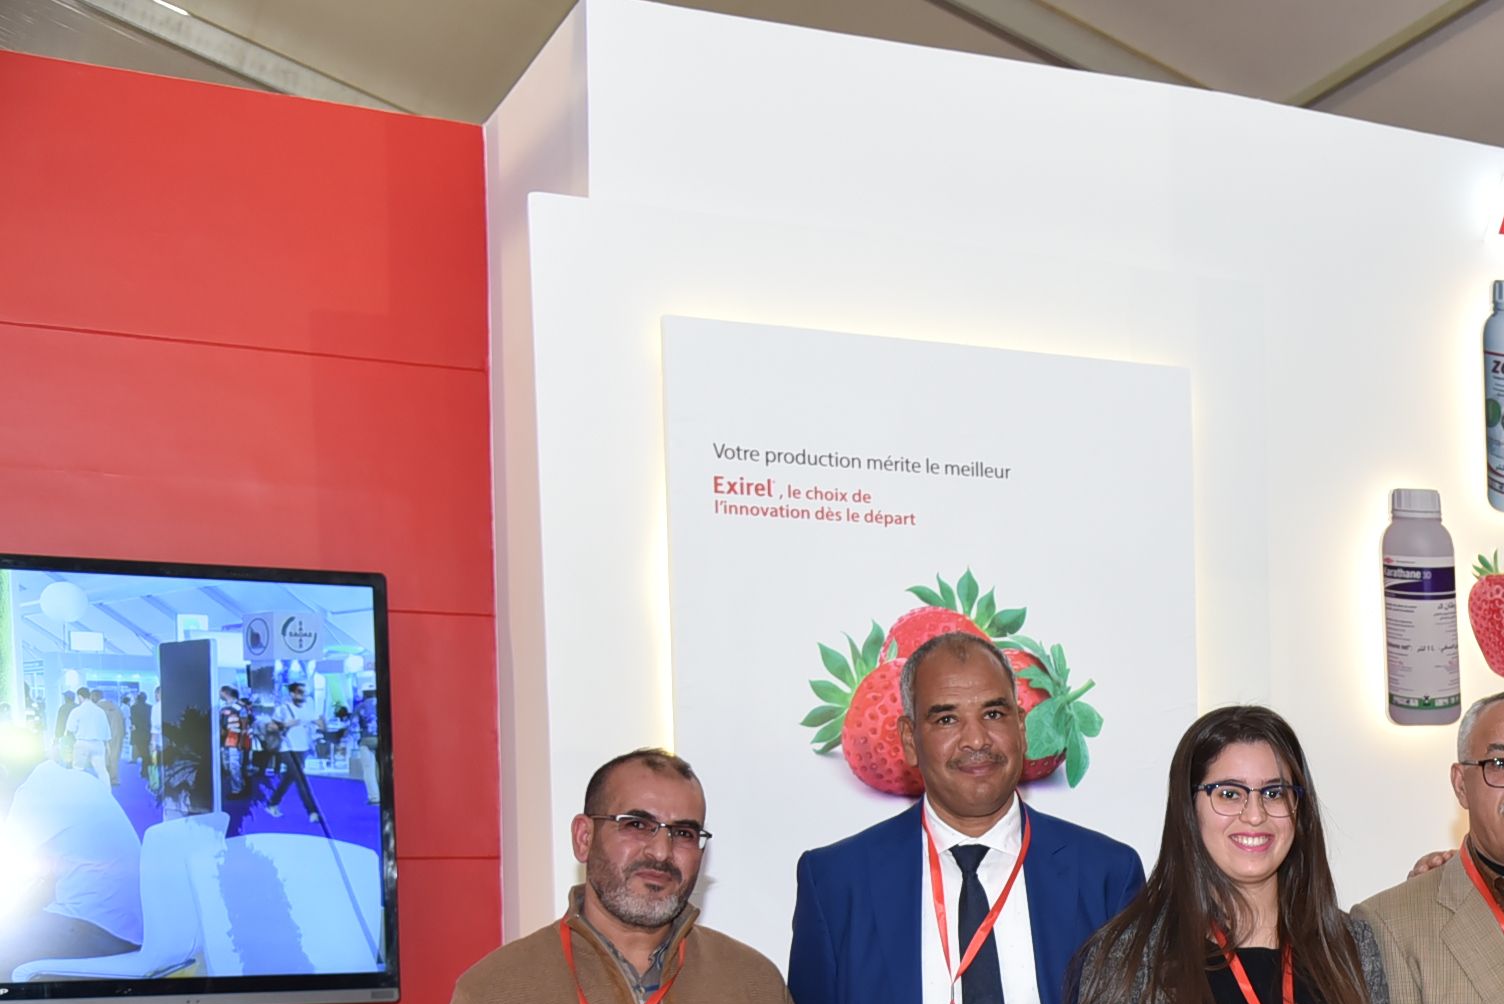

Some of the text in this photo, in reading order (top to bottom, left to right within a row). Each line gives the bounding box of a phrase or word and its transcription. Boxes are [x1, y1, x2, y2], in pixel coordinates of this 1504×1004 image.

[712, 442, 1011, 480] Votre production mérite le meilleur
[713, 475, 773, 497] Exirel
[787, 484, 801, 500] le
[805, 486, 848, 503] choix
[851, 489, 872, 504] de
[714, 500, 916, 528] l'innovation dès le départ
